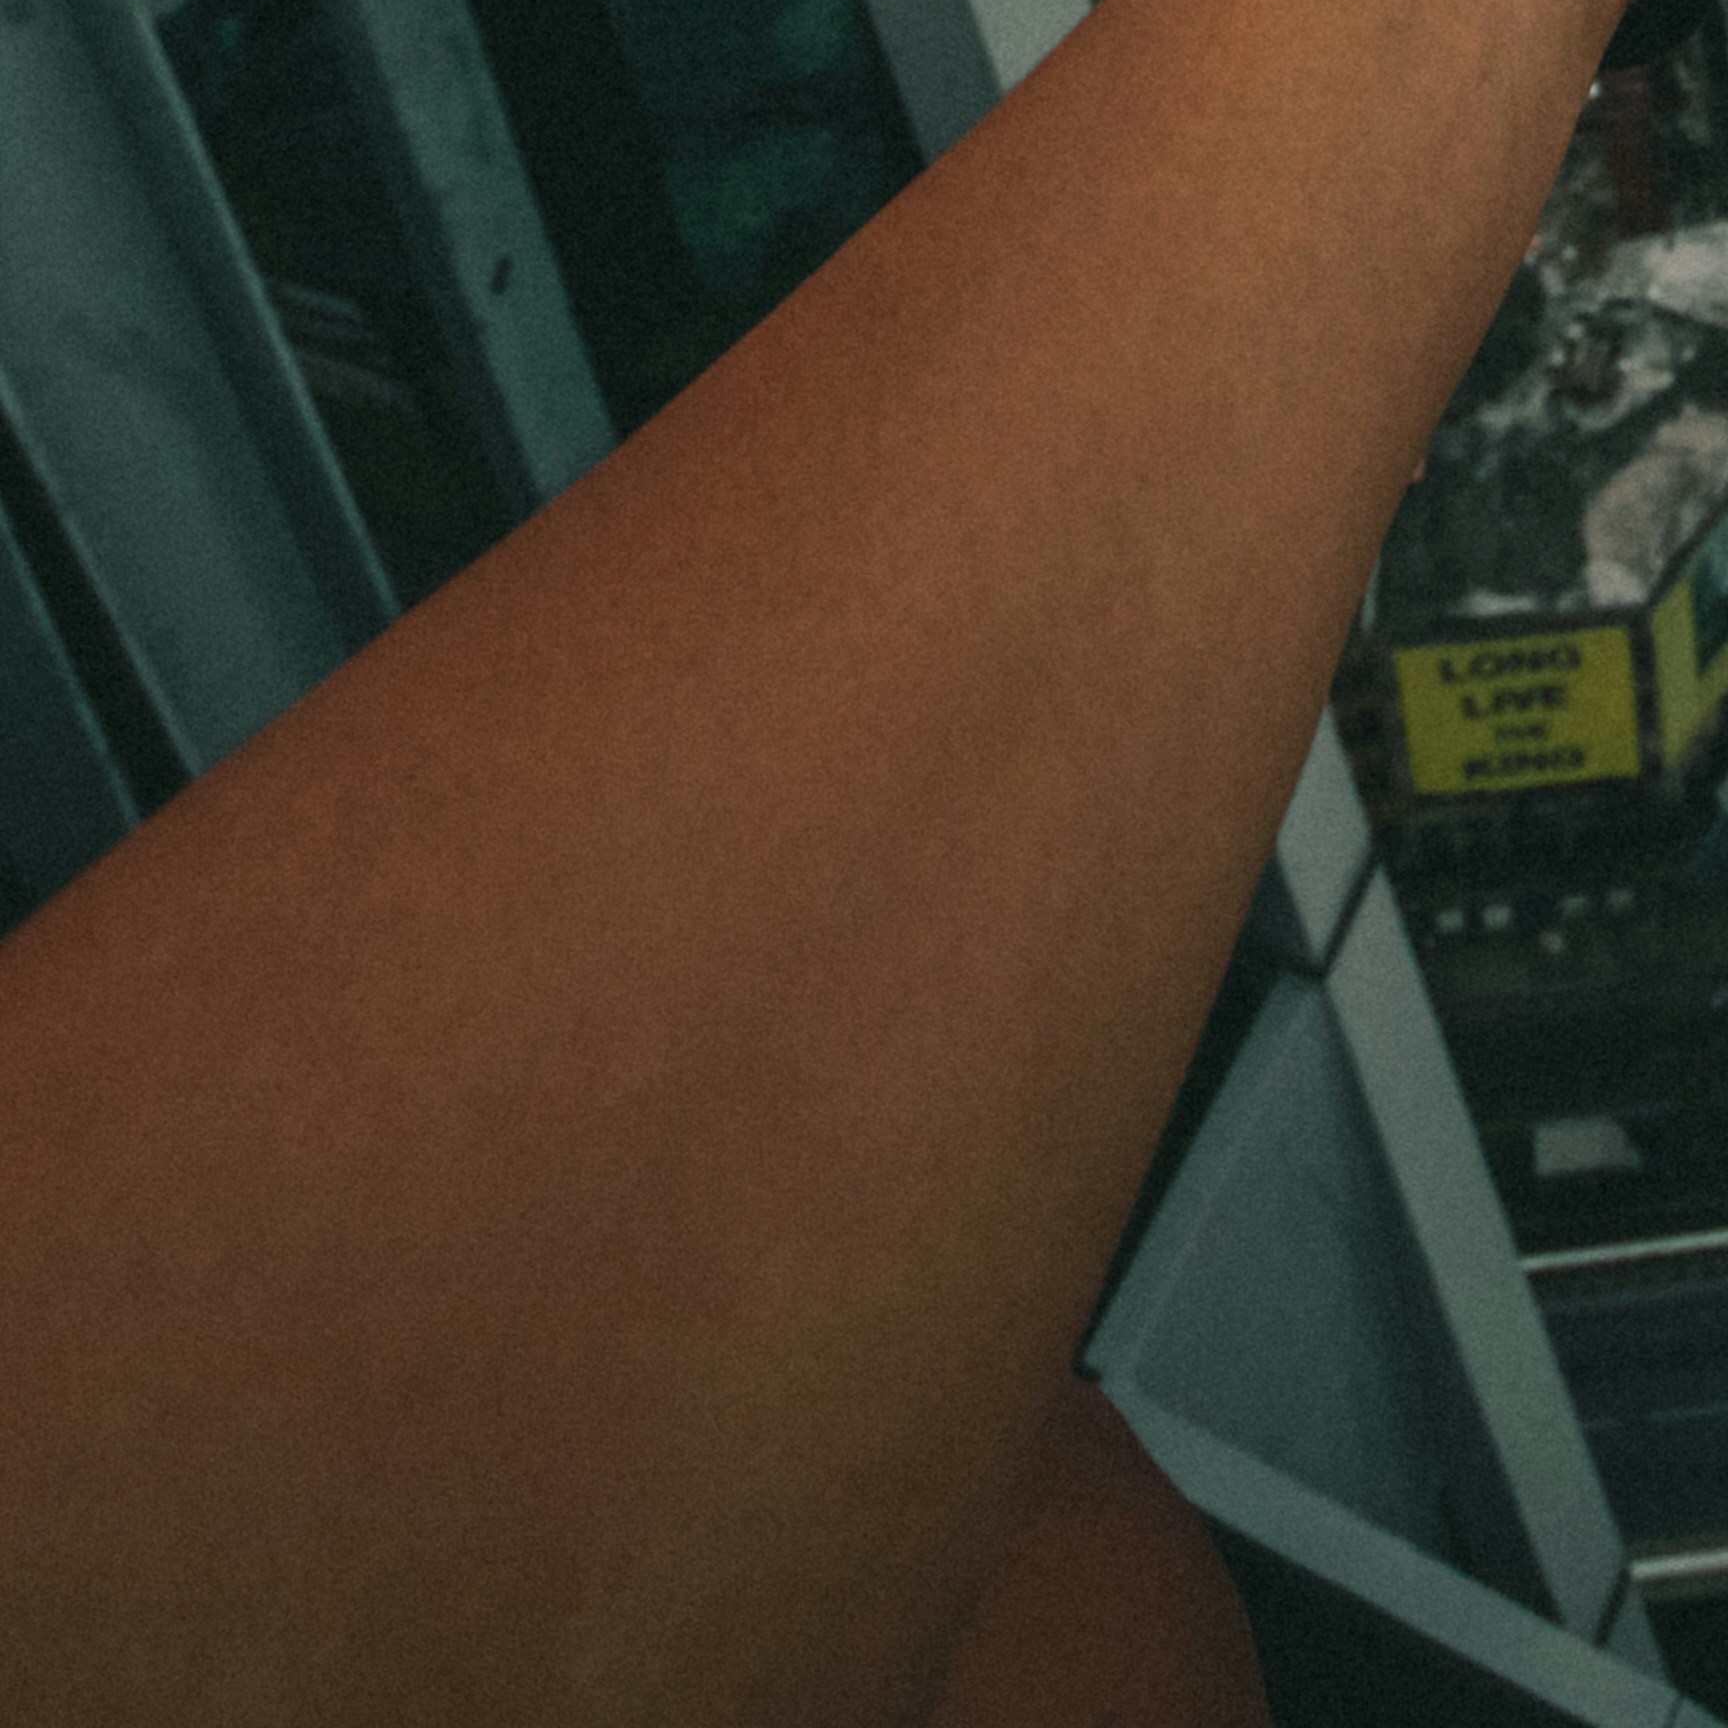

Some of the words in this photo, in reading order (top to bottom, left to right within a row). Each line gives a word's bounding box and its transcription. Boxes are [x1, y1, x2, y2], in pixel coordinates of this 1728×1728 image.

[1438, 644, 1583, 685] LONG
[1461, 684, 1567, 722] LIVE
[1462, 746, 1586, 780] KING
